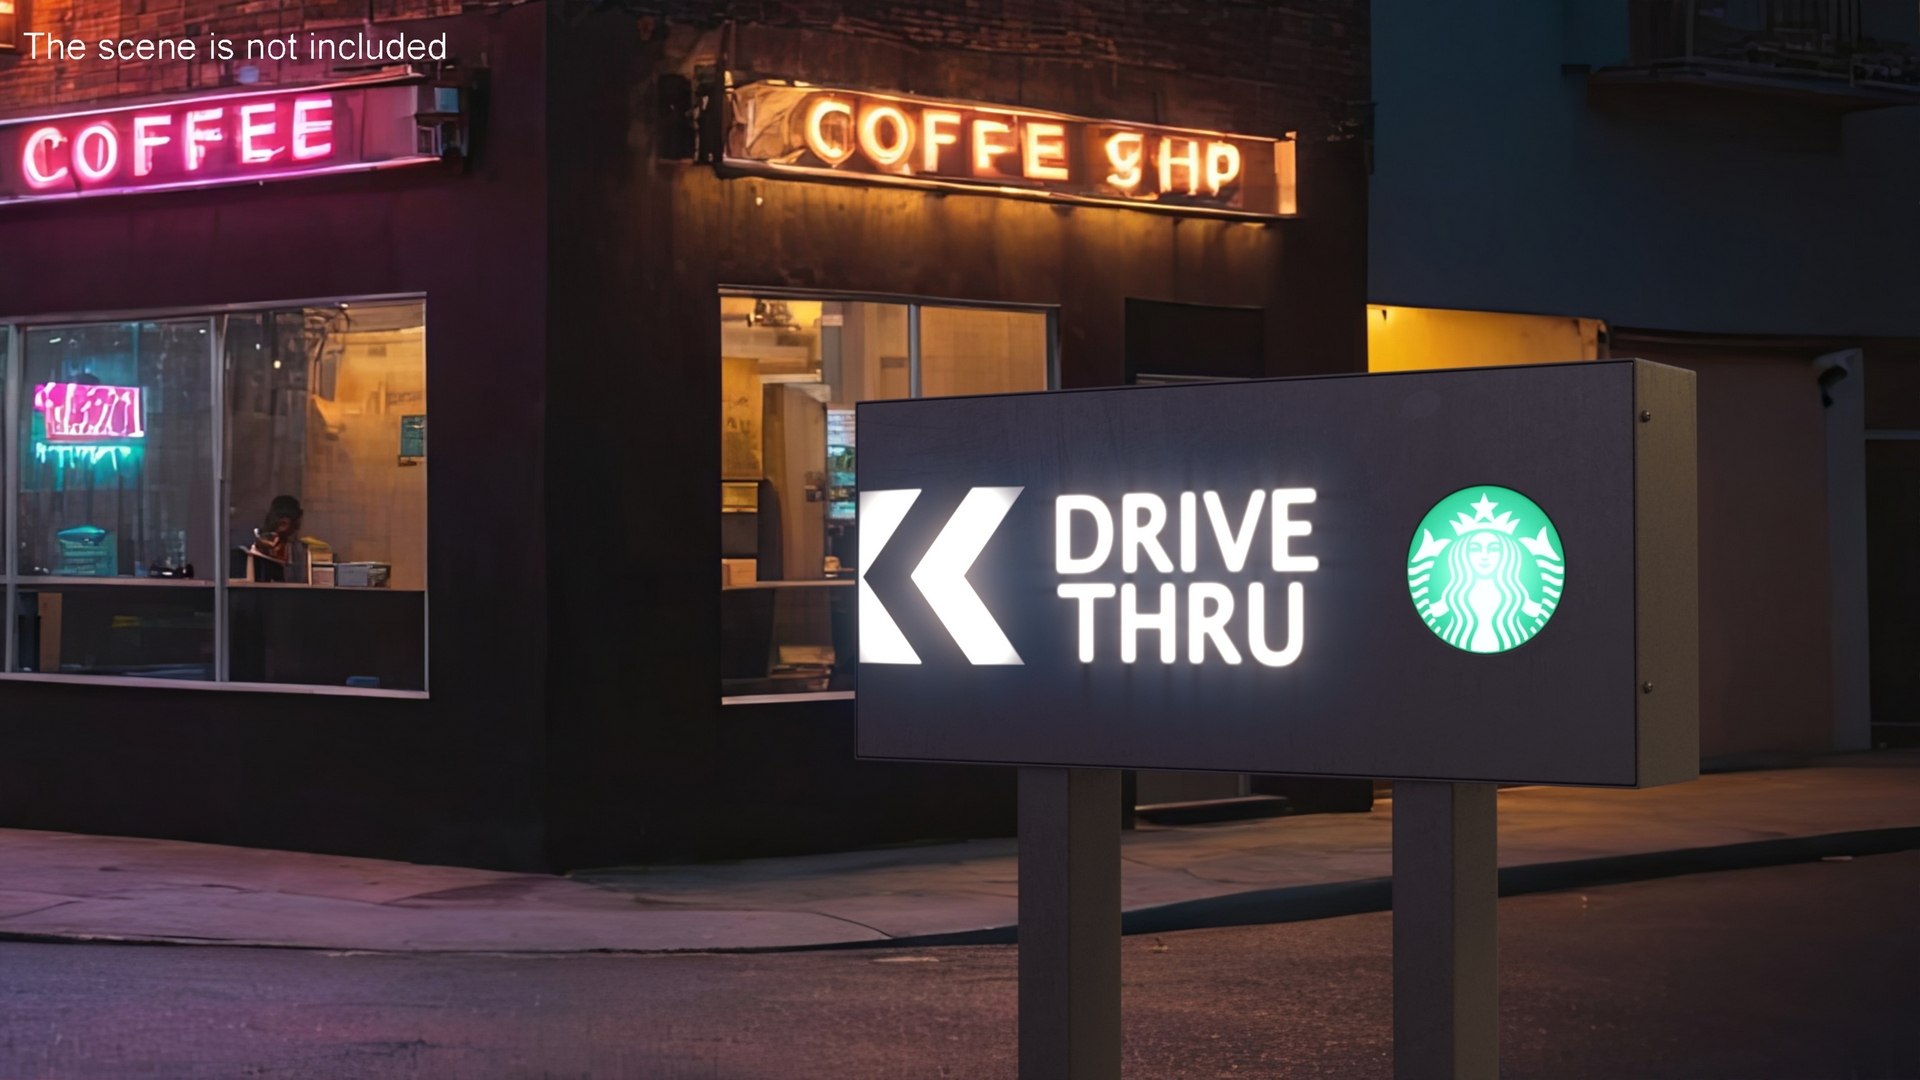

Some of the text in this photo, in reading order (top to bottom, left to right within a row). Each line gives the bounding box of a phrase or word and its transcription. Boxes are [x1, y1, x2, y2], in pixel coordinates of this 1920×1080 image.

[24, 98, 334, 187] COFFEE
[805, 100, 1069, 180] COFFE
[1055, 487, 1319, 574] DRIVE
[1057, 581, 1304, 668] THRU
